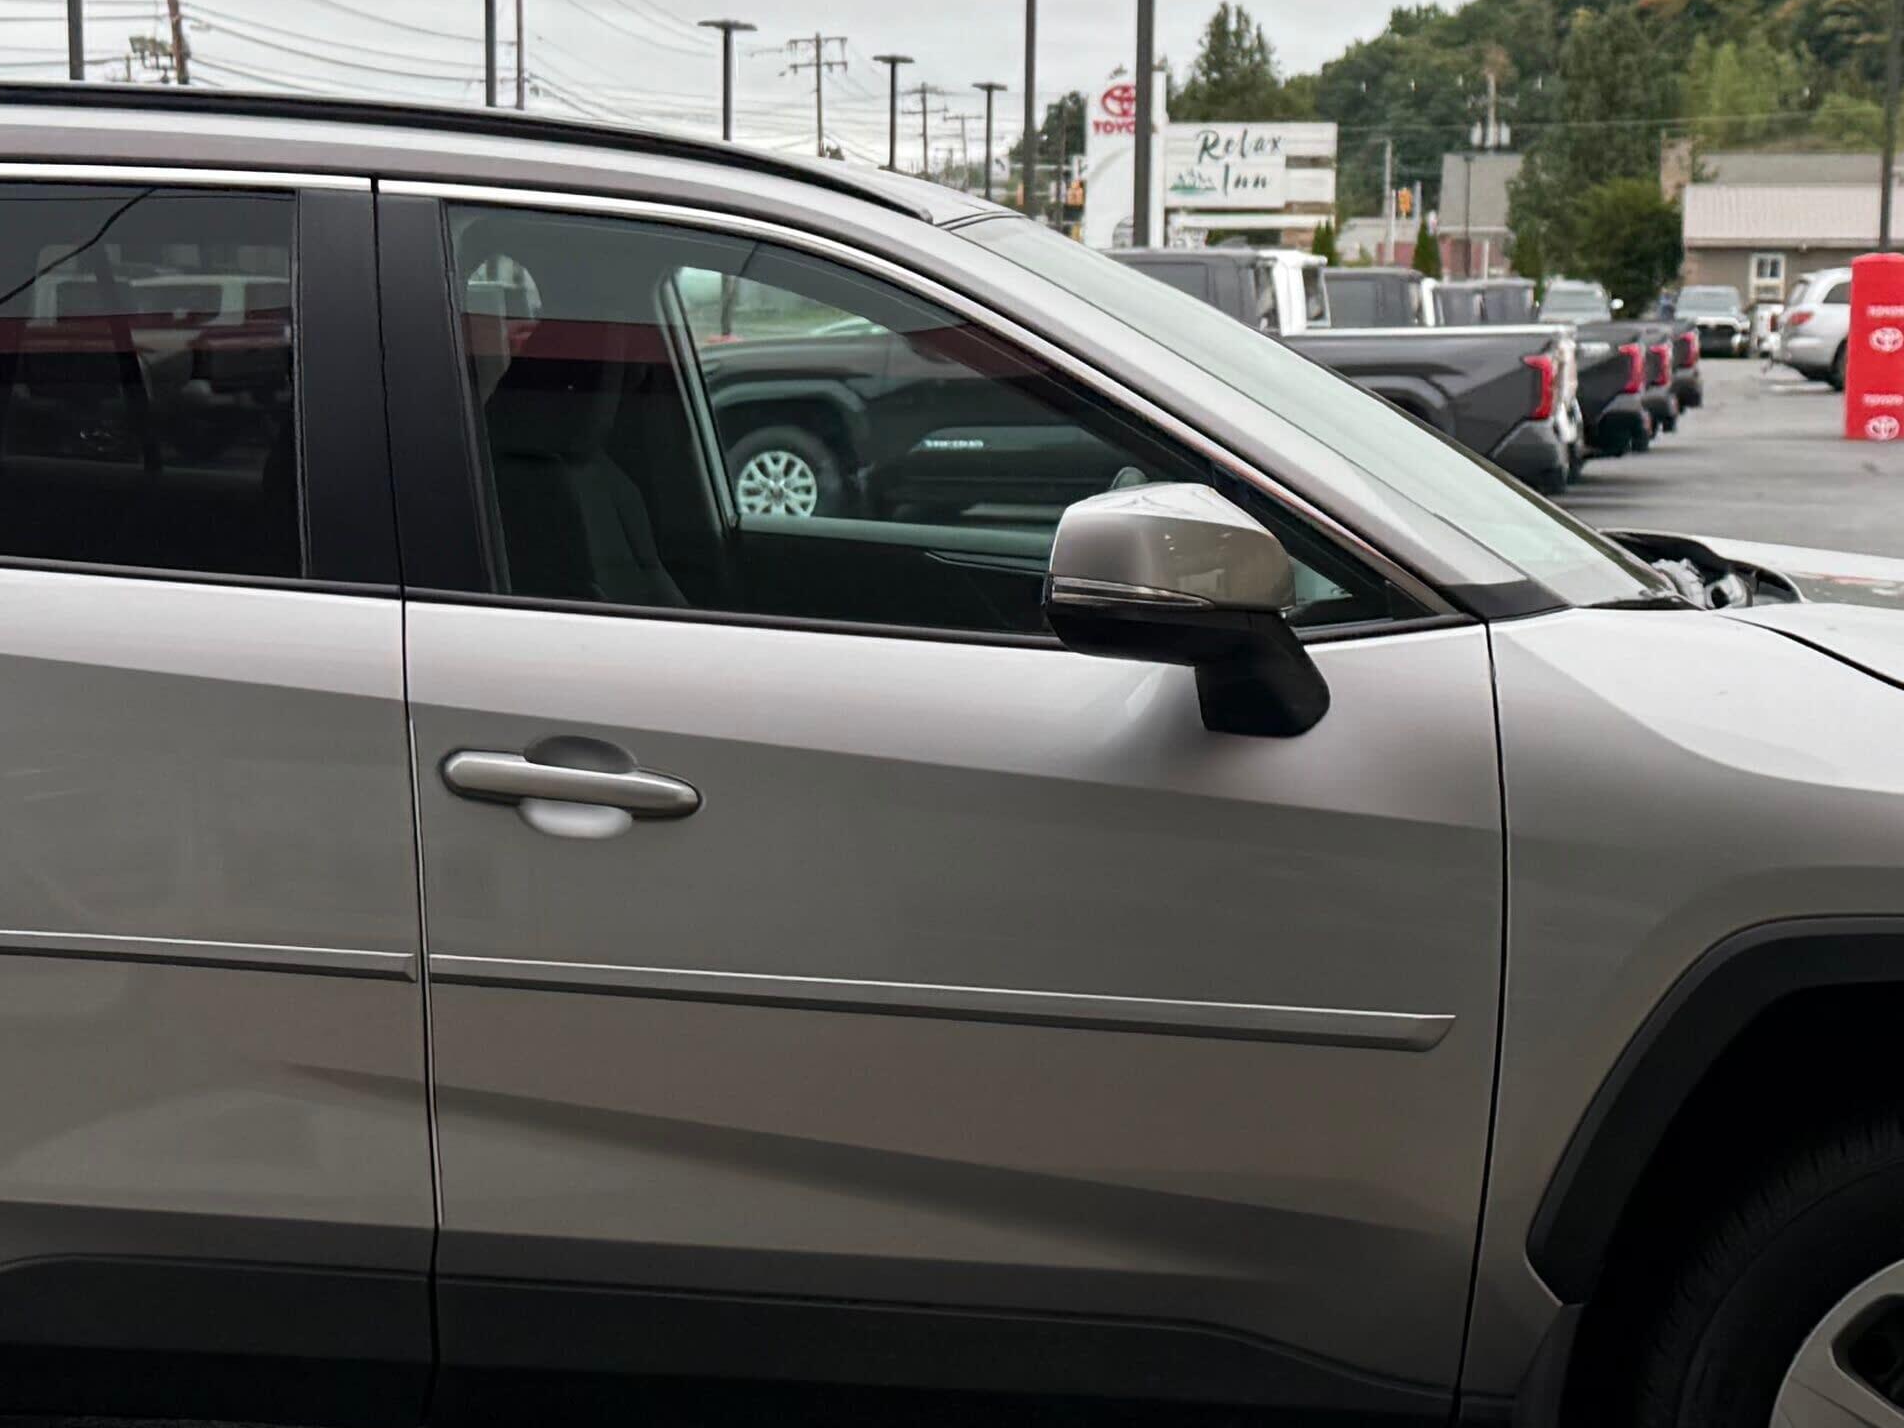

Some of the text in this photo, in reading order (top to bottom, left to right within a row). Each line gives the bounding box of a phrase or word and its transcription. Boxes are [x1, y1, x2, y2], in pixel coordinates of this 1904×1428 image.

[1093, 120, 1158, 135] TOYO
[1197, 127, 1283, 164] Relax
[1222, 163, 1269, 197] Inn
